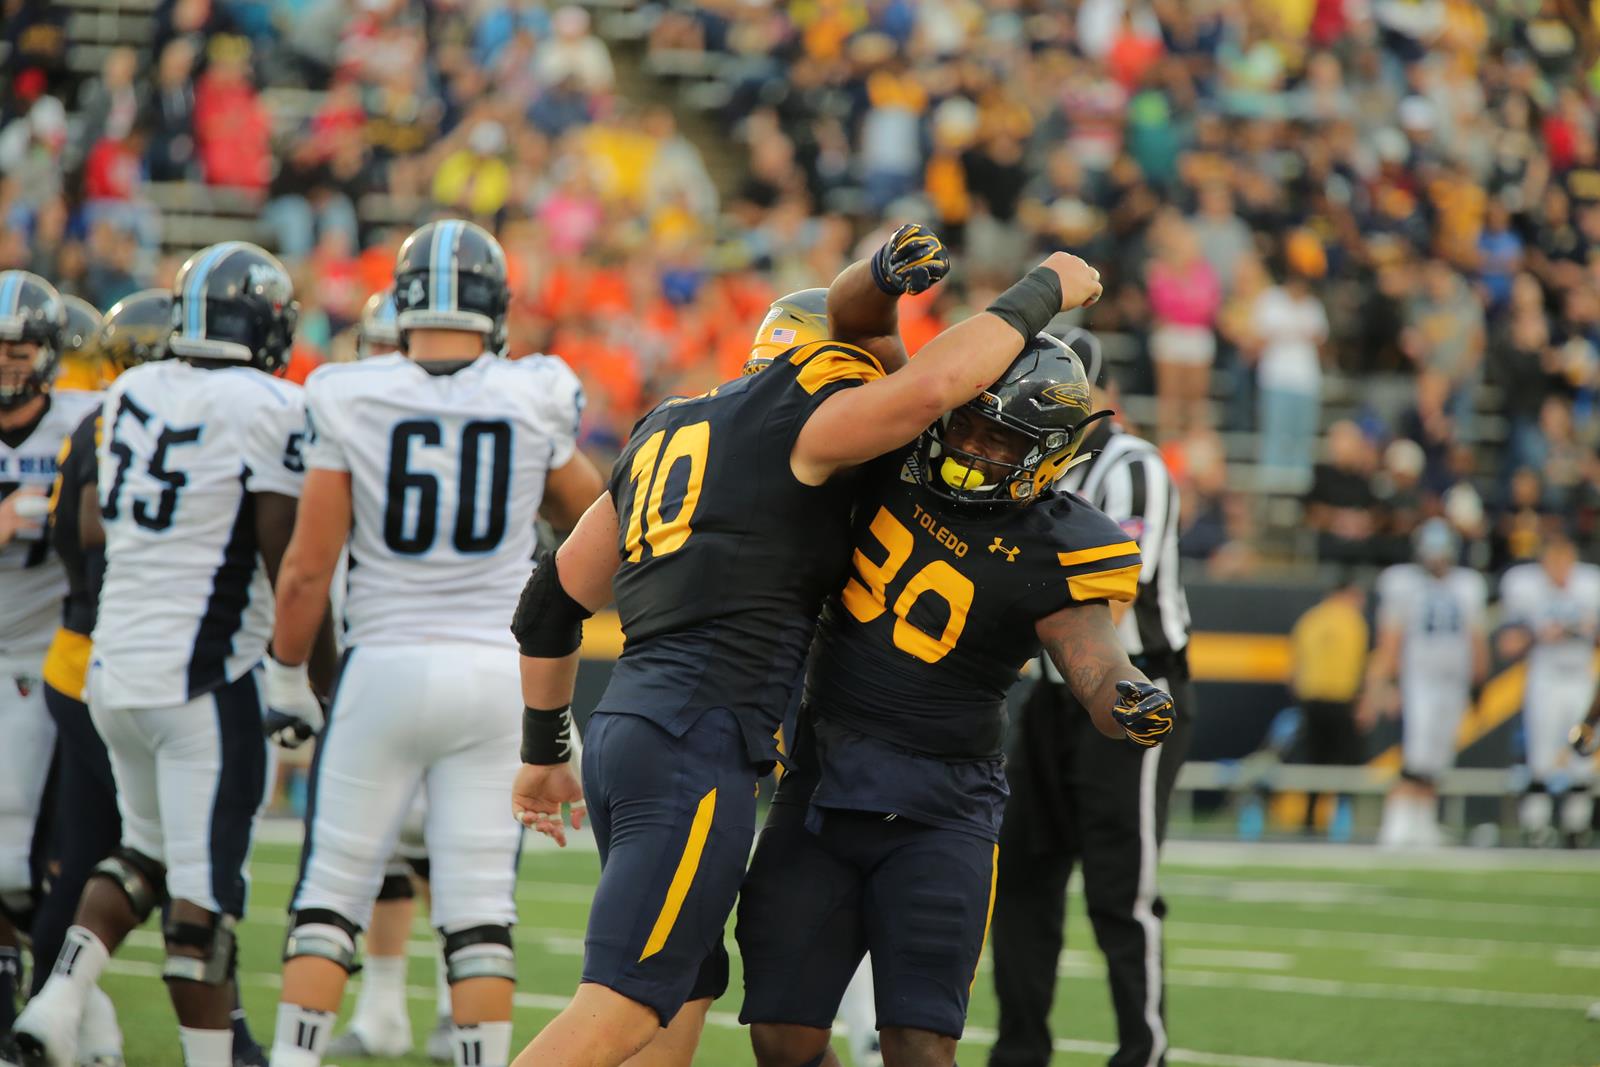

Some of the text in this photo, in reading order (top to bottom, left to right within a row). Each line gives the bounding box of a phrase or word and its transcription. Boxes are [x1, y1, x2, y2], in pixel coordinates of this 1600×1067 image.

[384, 419, 512, 555] 60
[625, 420, 711, 563] 10
[912, 503, 969, 558] TOLEDO
[841, 505, 975, 664] 30
